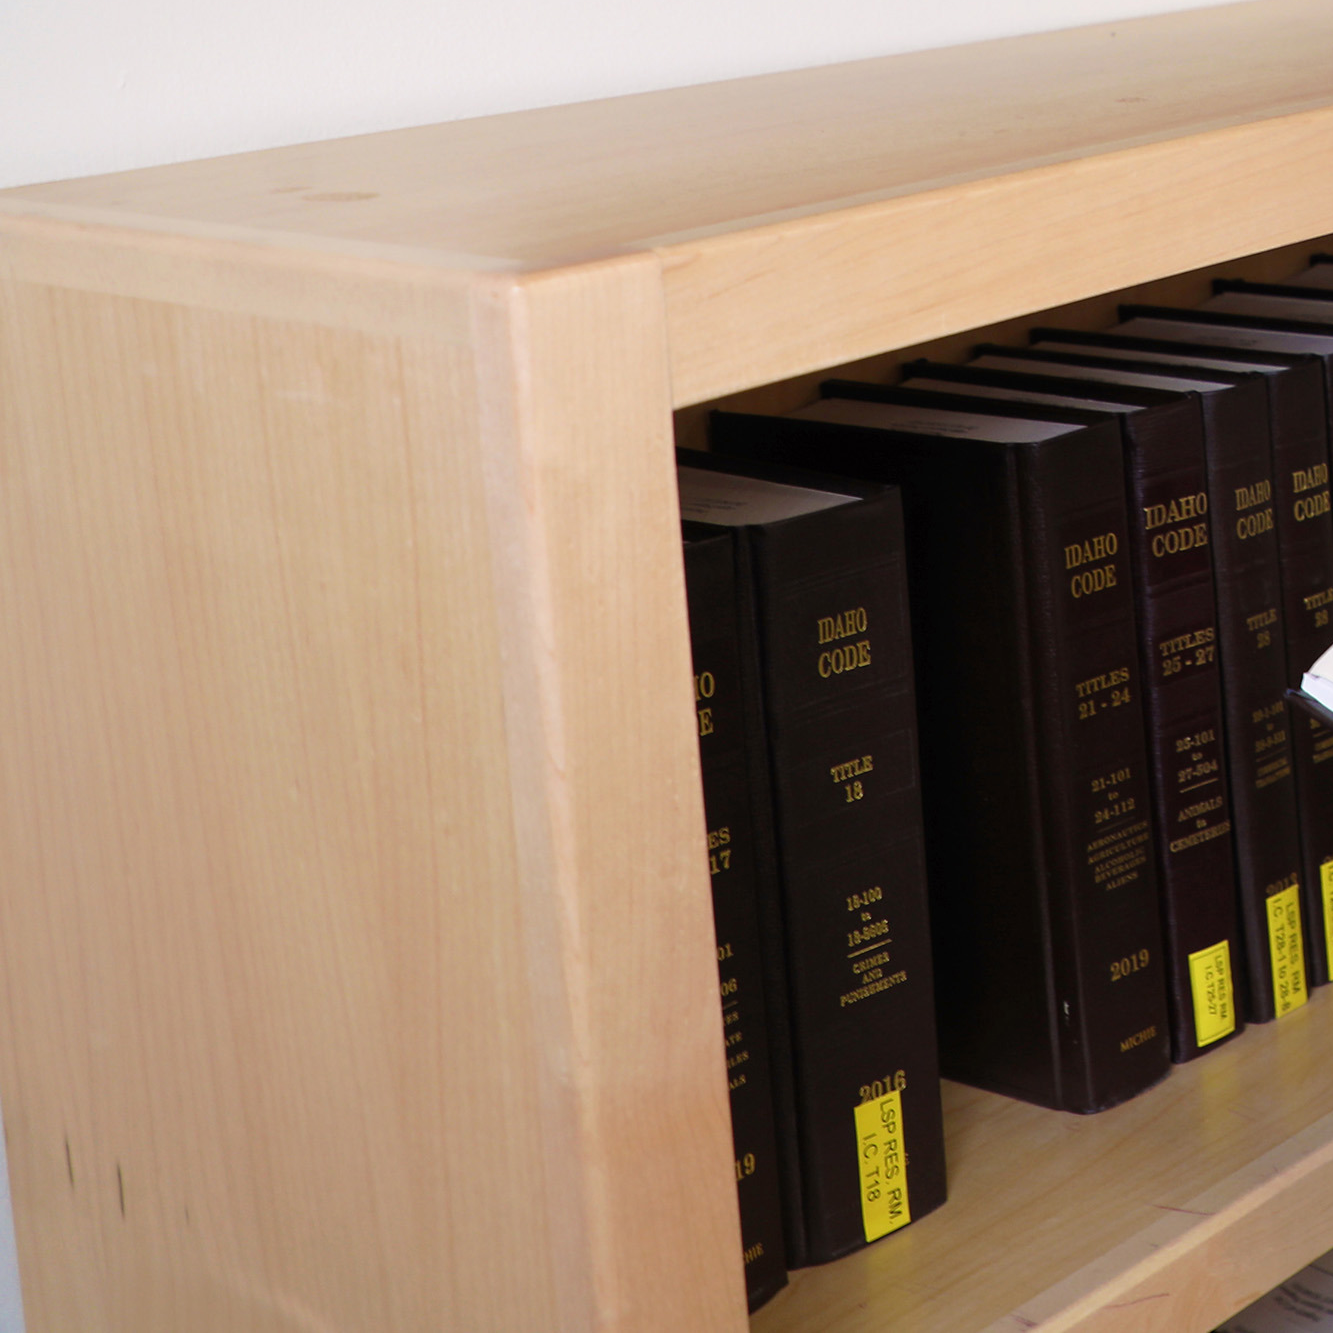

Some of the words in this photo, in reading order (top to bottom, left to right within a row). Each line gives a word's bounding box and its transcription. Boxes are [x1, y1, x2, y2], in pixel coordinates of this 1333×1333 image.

[1291, 462, 1329, 494] IDAHO
[1142, 491, 1208, 530] IDAHO
[1235, 479, 1271, 511] IDAHO
[1293, 490, 1332, 522] CODE
[1236, 508, 1274, 540] CODE
[1064, 532, 1118, 570] IDAHO
[1151, 523, 1208, 558] CODE
[1070, 564, 1117, 599] CODE
[817, 606, 867, 644] IDAHO
[1246, 608, 1277, 631] TITLE
[1159, 627, 1215, 658] TITLES
[818, 640, 872, 679] CODE
[1162, 656, 1181, 677] 25
[1195, 646, 1215, 666] 27
[1075, 666, 1130, 699] TITLES
[1078, 698, 1097, 720] 21
[1110, 686, 1132, 707] 24
[830, 755, 874, 784] TITLE
[1091, 767, 1132, 792] 21-101
[845, 781, 864, 803] 18
[709, 849, 732, 875] 17
[853, 951, 890, 974] CRIMES
[862, 968, 883, 984] AND
[1110, 948, 1150, 982] 2019
[840, 970, 908, 1007] PUNISHMENTS
[1119, 1026, 1158, 1052] MICHIE
[859, 1069, 908, 1104] 2016
[879, 1098, 897, 1134] LSP
[735, 1153, 757, 1181] 19
[883, 1138, 900, 1185] RES.
[865, 1165, 881, 1202] T18
